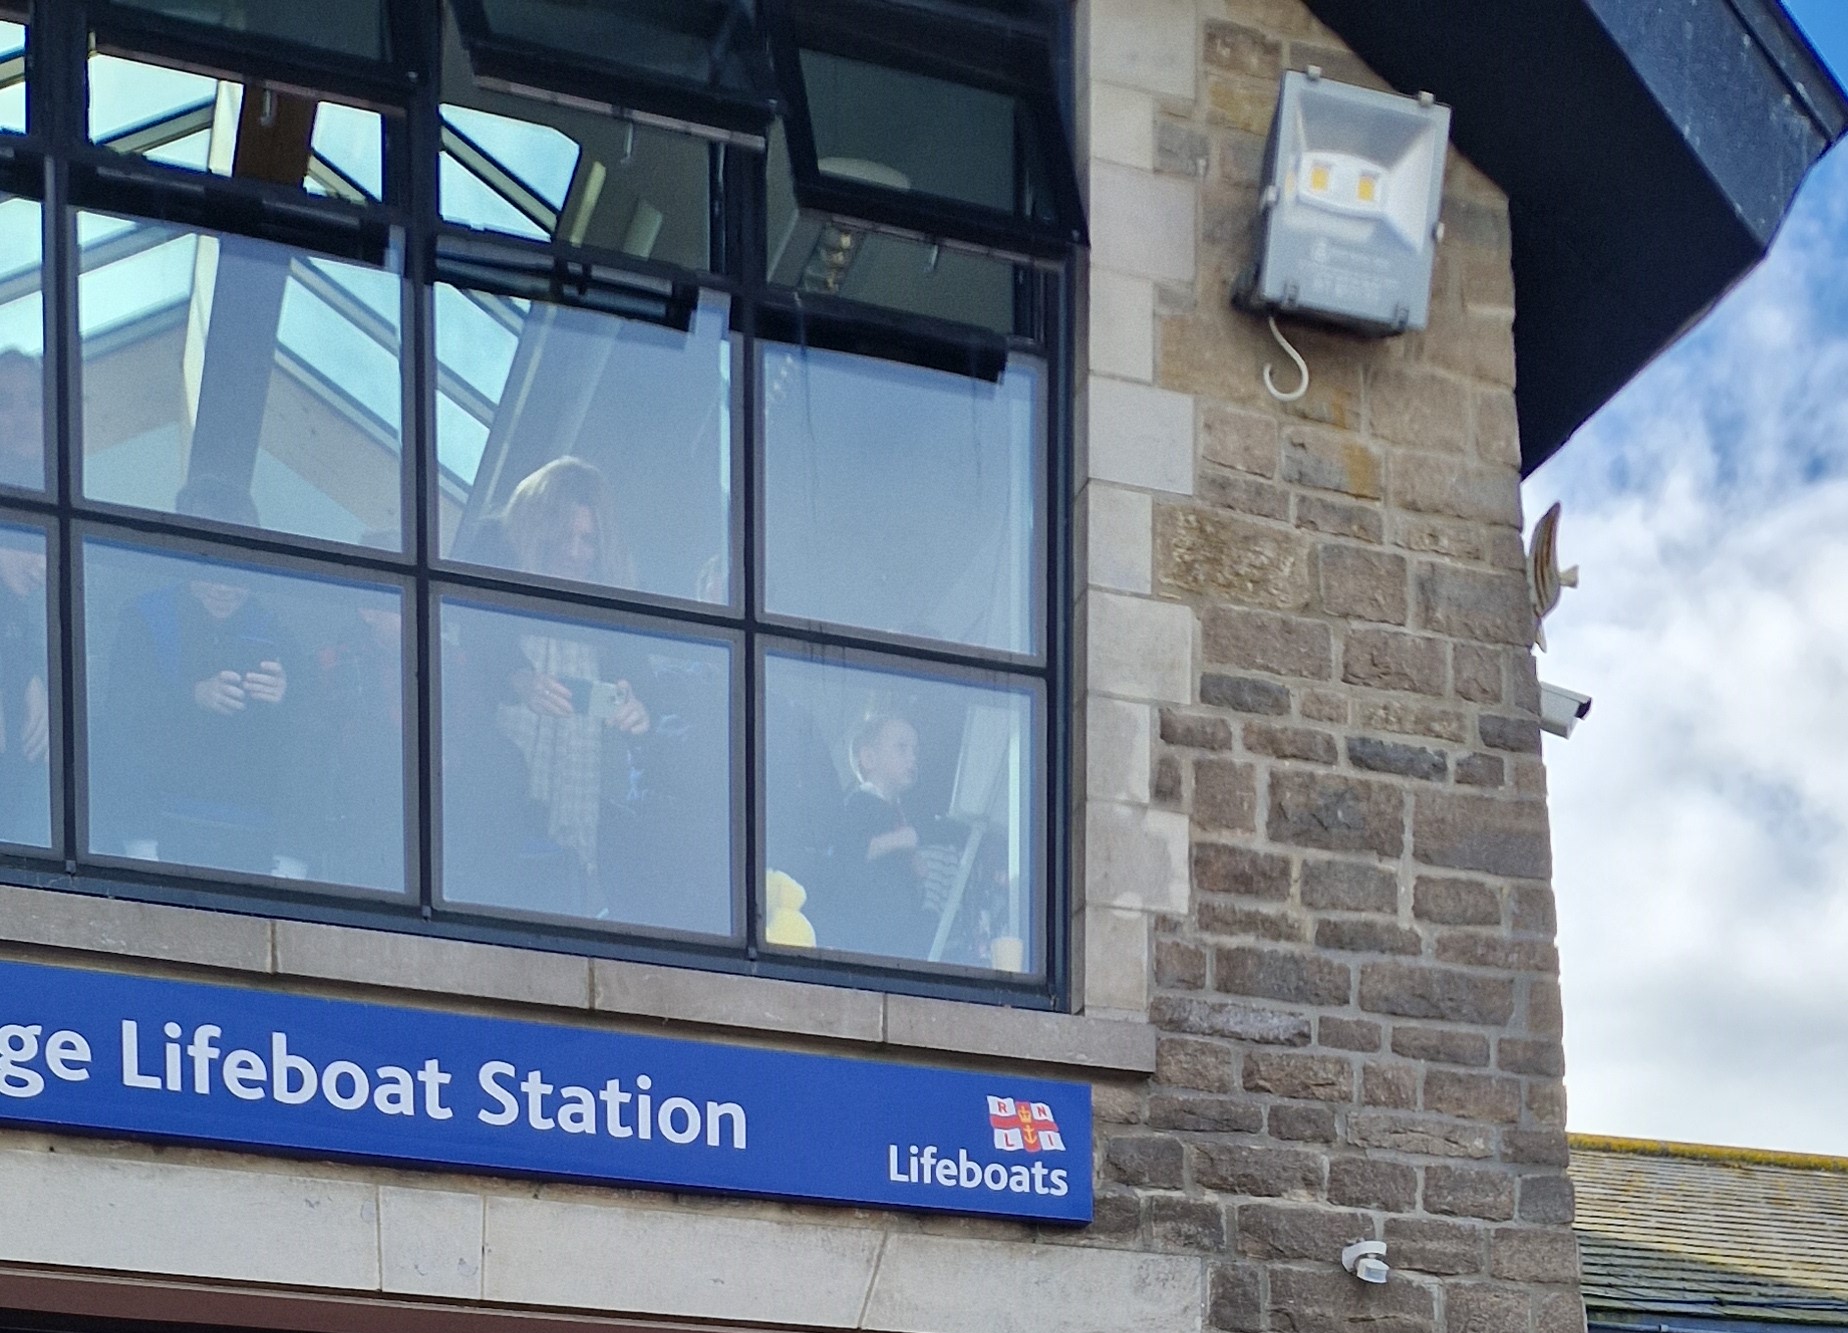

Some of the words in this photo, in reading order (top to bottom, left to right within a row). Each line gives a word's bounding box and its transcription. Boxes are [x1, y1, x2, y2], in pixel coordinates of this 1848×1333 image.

[0, 1024, 92, 1097] ge
[121, 1019, 453, 1120] Lifeboat
[477, 1060, 747, 1150] Station
[889, 1144, 1069, 1197] Lifeboats
